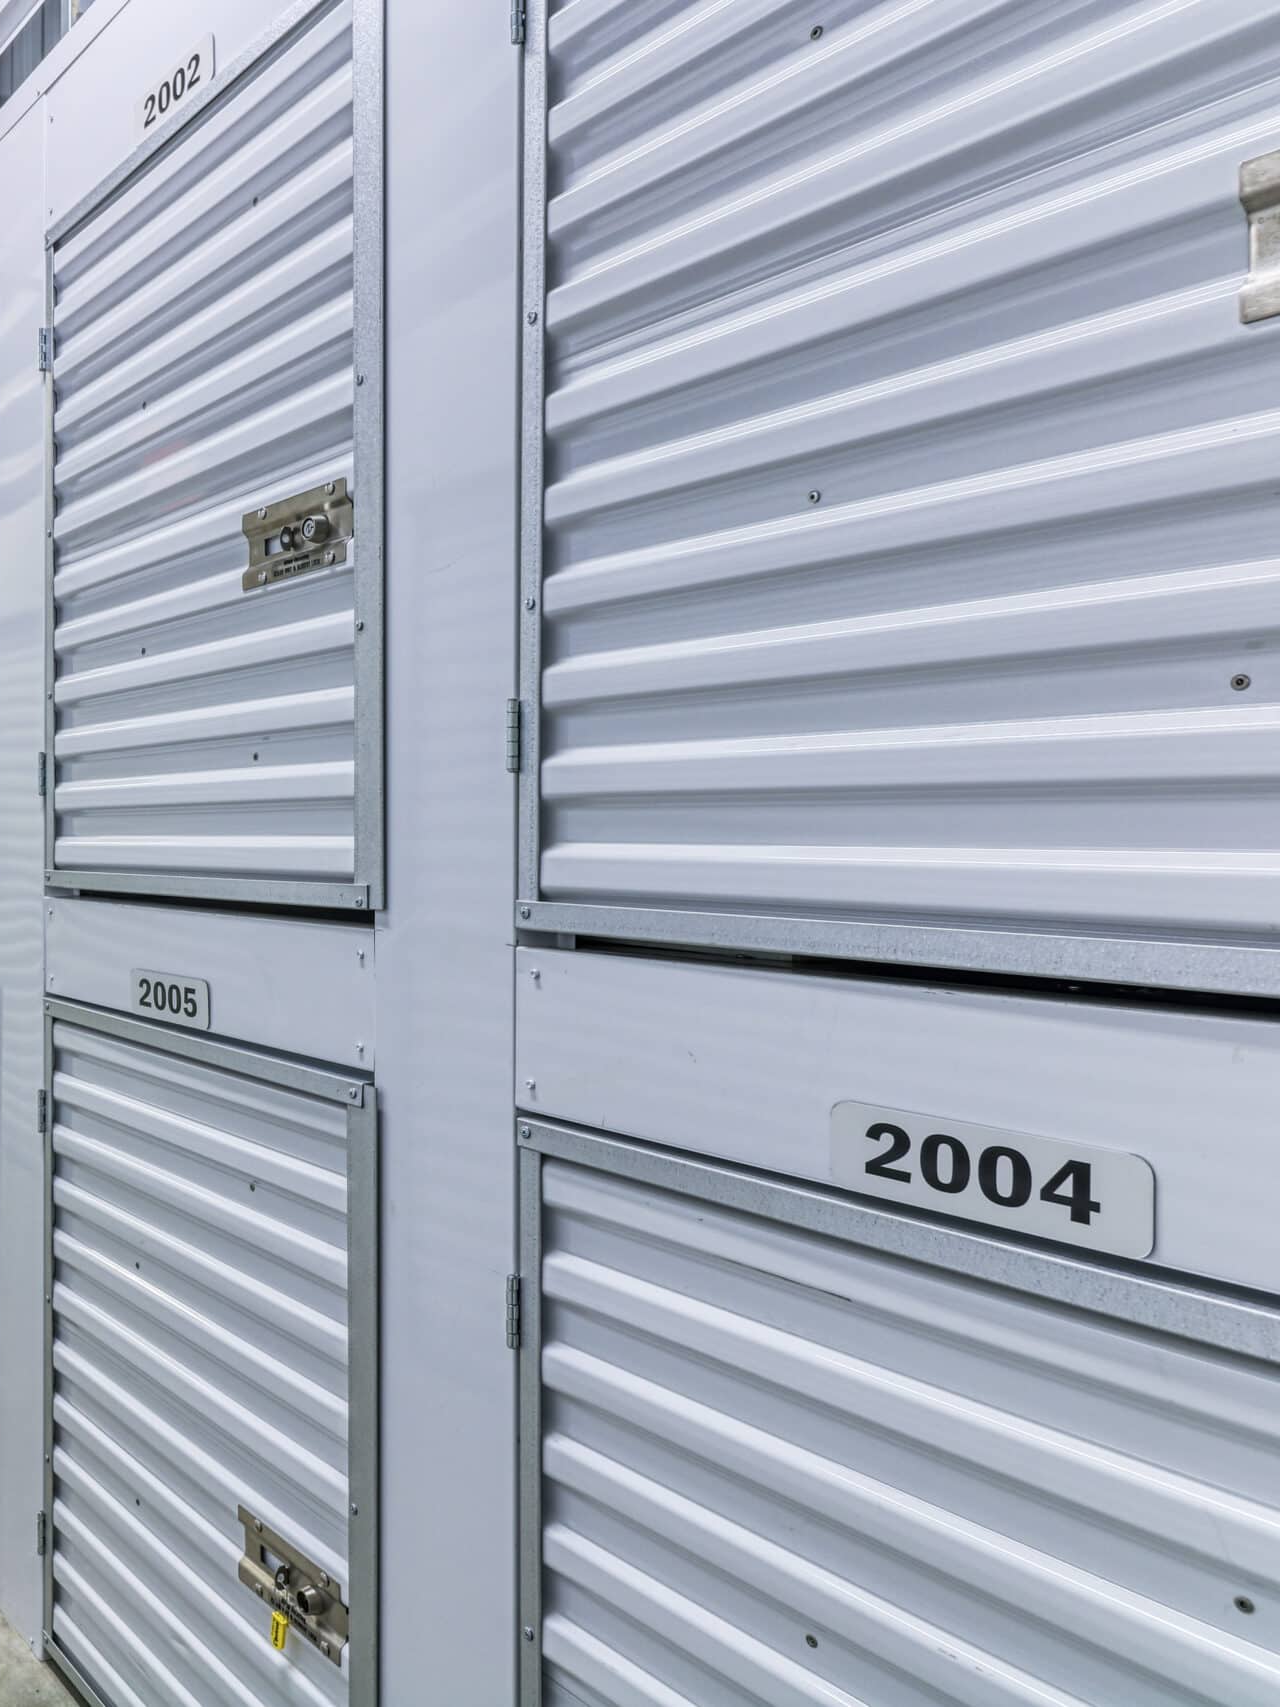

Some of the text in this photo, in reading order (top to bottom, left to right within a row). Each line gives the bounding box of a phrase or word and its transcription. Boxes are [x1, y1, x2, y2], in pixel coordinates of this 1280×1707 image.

[143, 53, 201, 129] 2002
[138, 977, 198, 1018] 2005
[864, 1122, 1101, 1226] 2004
